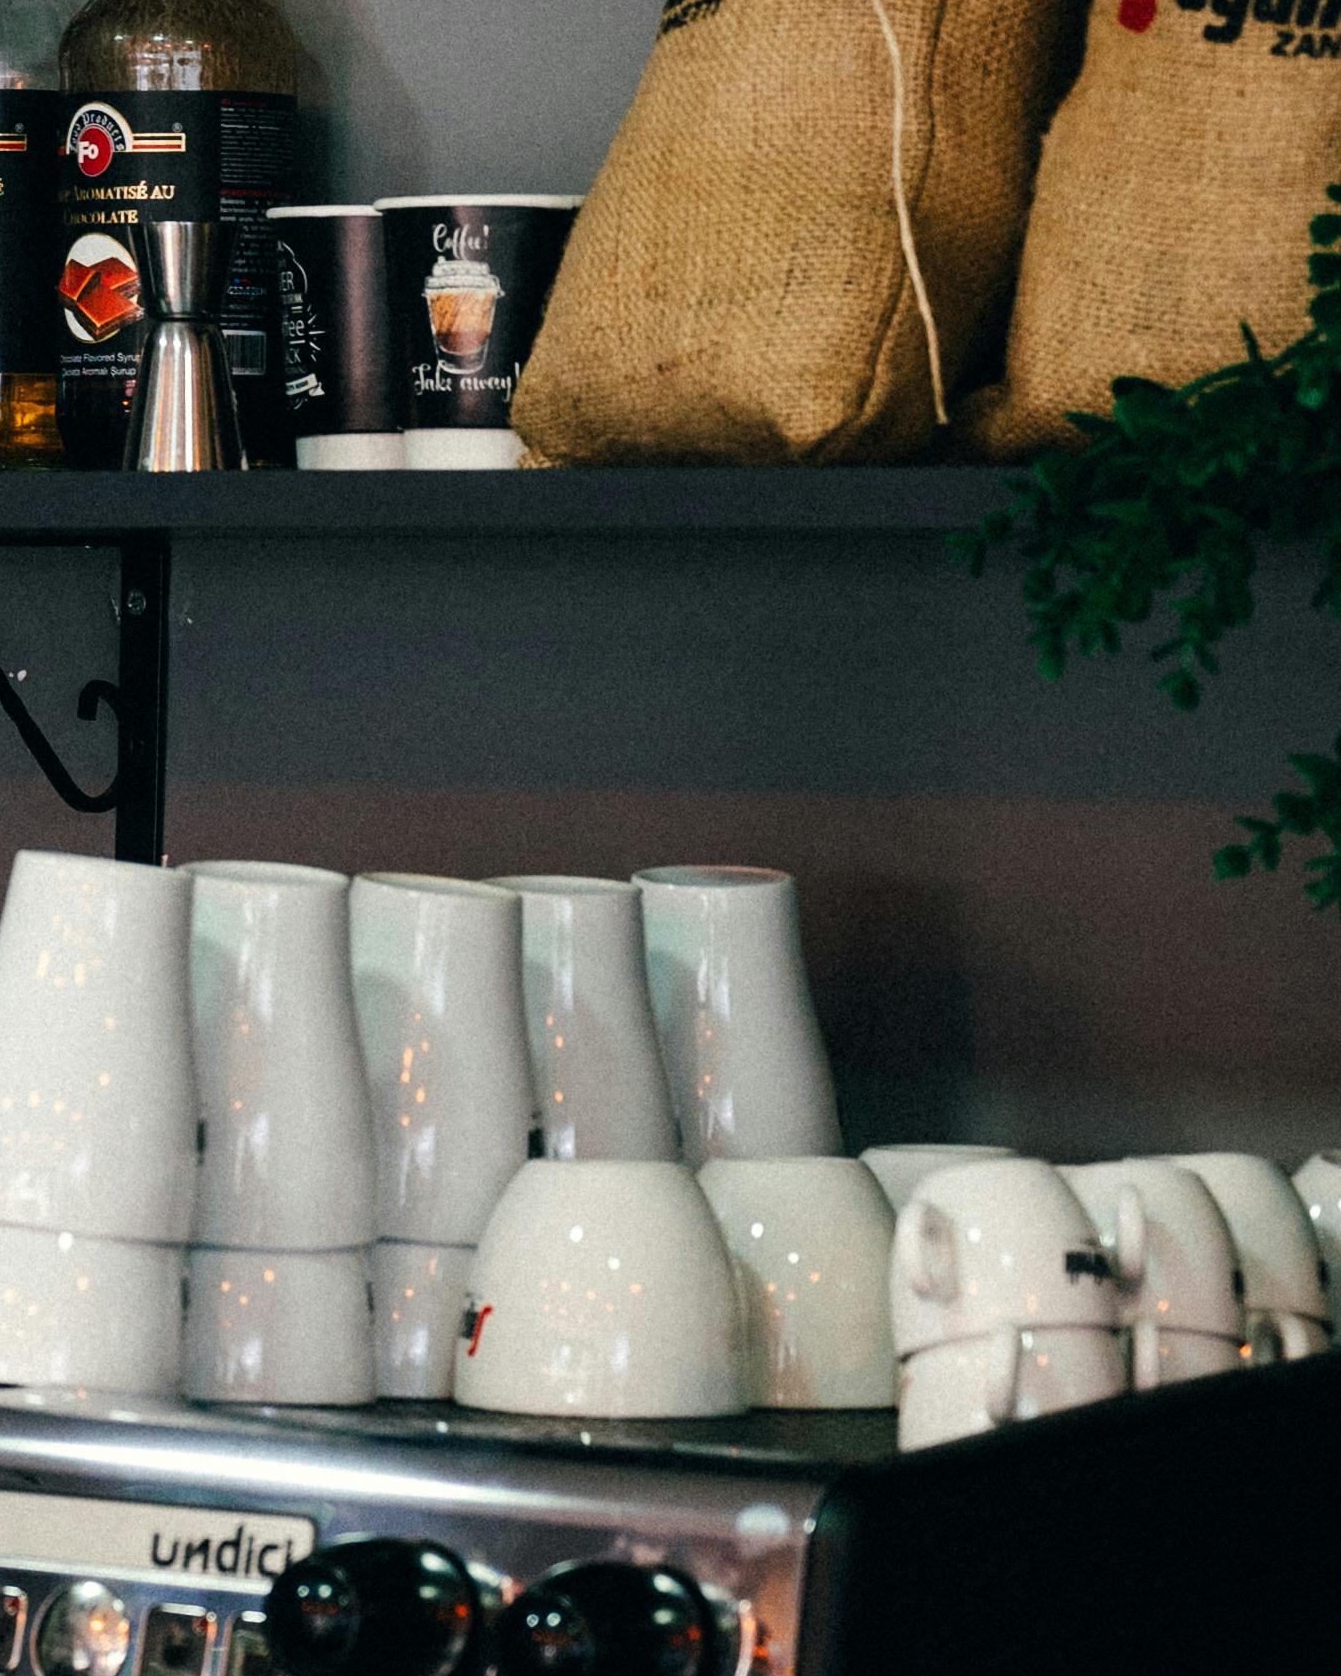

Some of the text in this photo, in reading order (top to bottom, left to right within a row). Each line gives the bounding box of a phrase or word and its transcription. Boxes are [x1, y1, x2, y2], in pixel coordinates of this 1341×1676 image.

[78, 141, 99, 164] Fo
[150, 185, 176, 200] AU
[151, 1524, 294, 1576] undici
